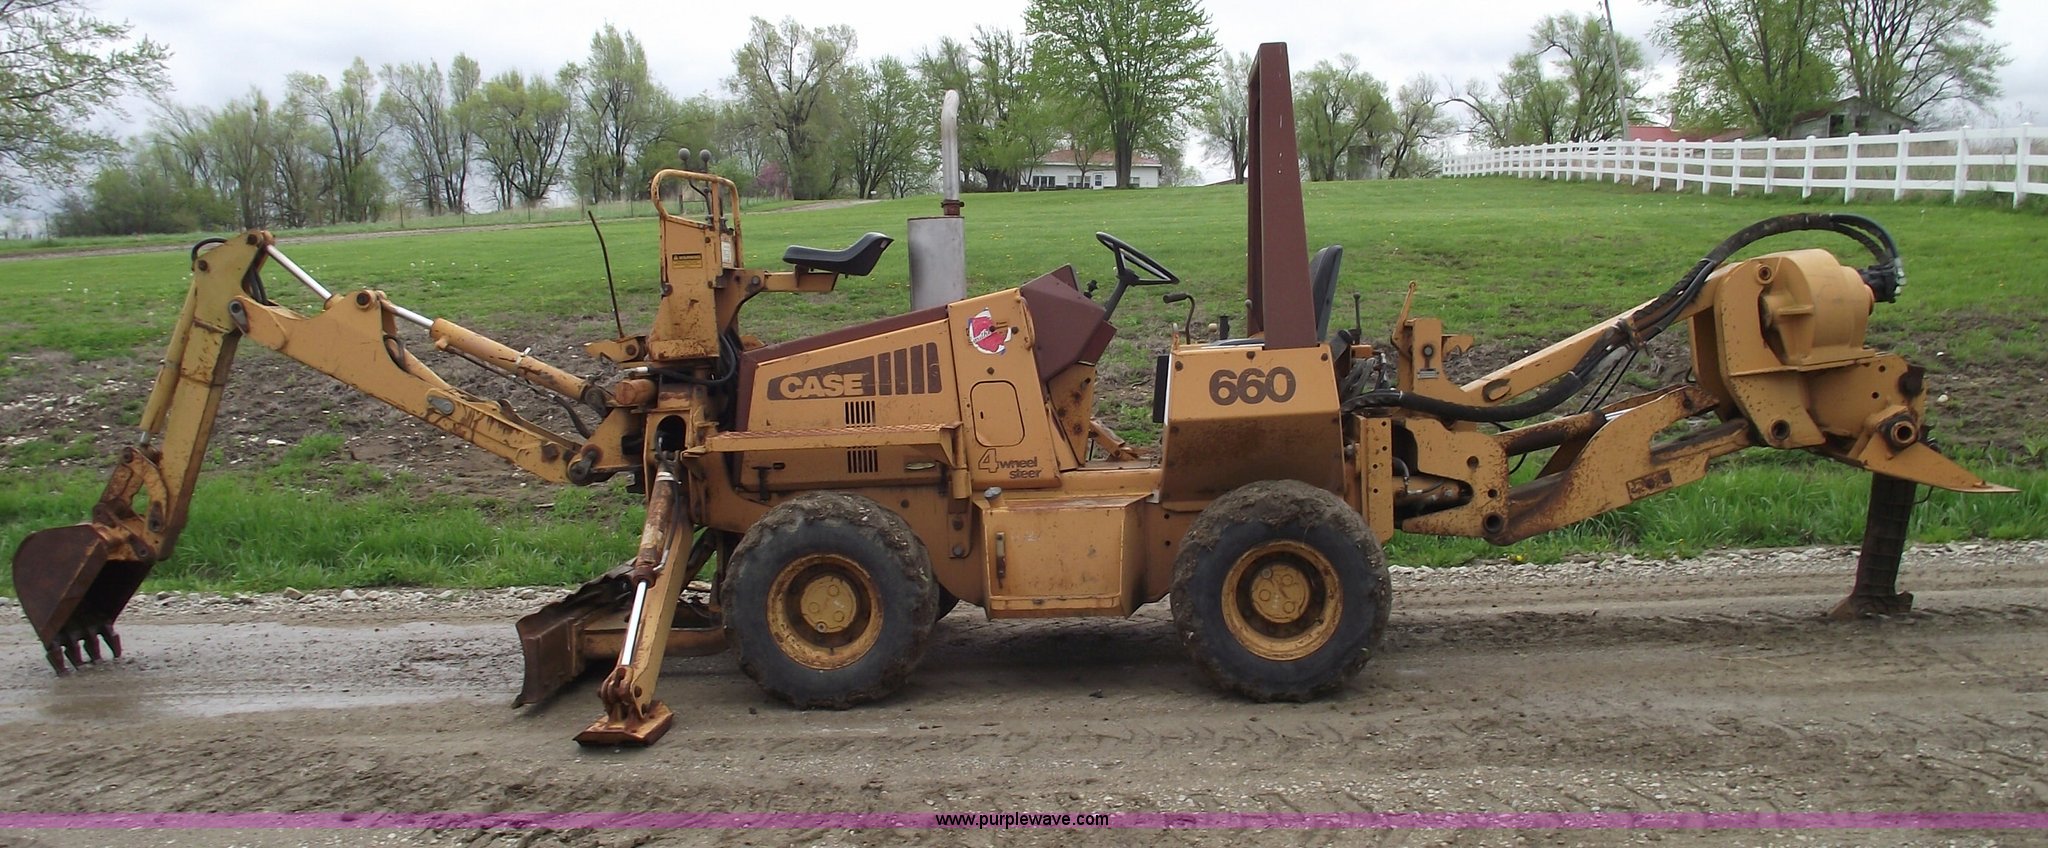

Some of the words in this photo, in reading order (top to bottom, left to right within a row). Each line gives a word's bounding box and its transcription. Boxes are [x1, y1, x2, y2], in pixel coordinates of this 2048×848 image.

[780, 374, 864, 399] CASE
[1209, 366, 1297, 405] 660
[978, 448, 999, 473] 4
[1009, 468, 1042, 479] steer
